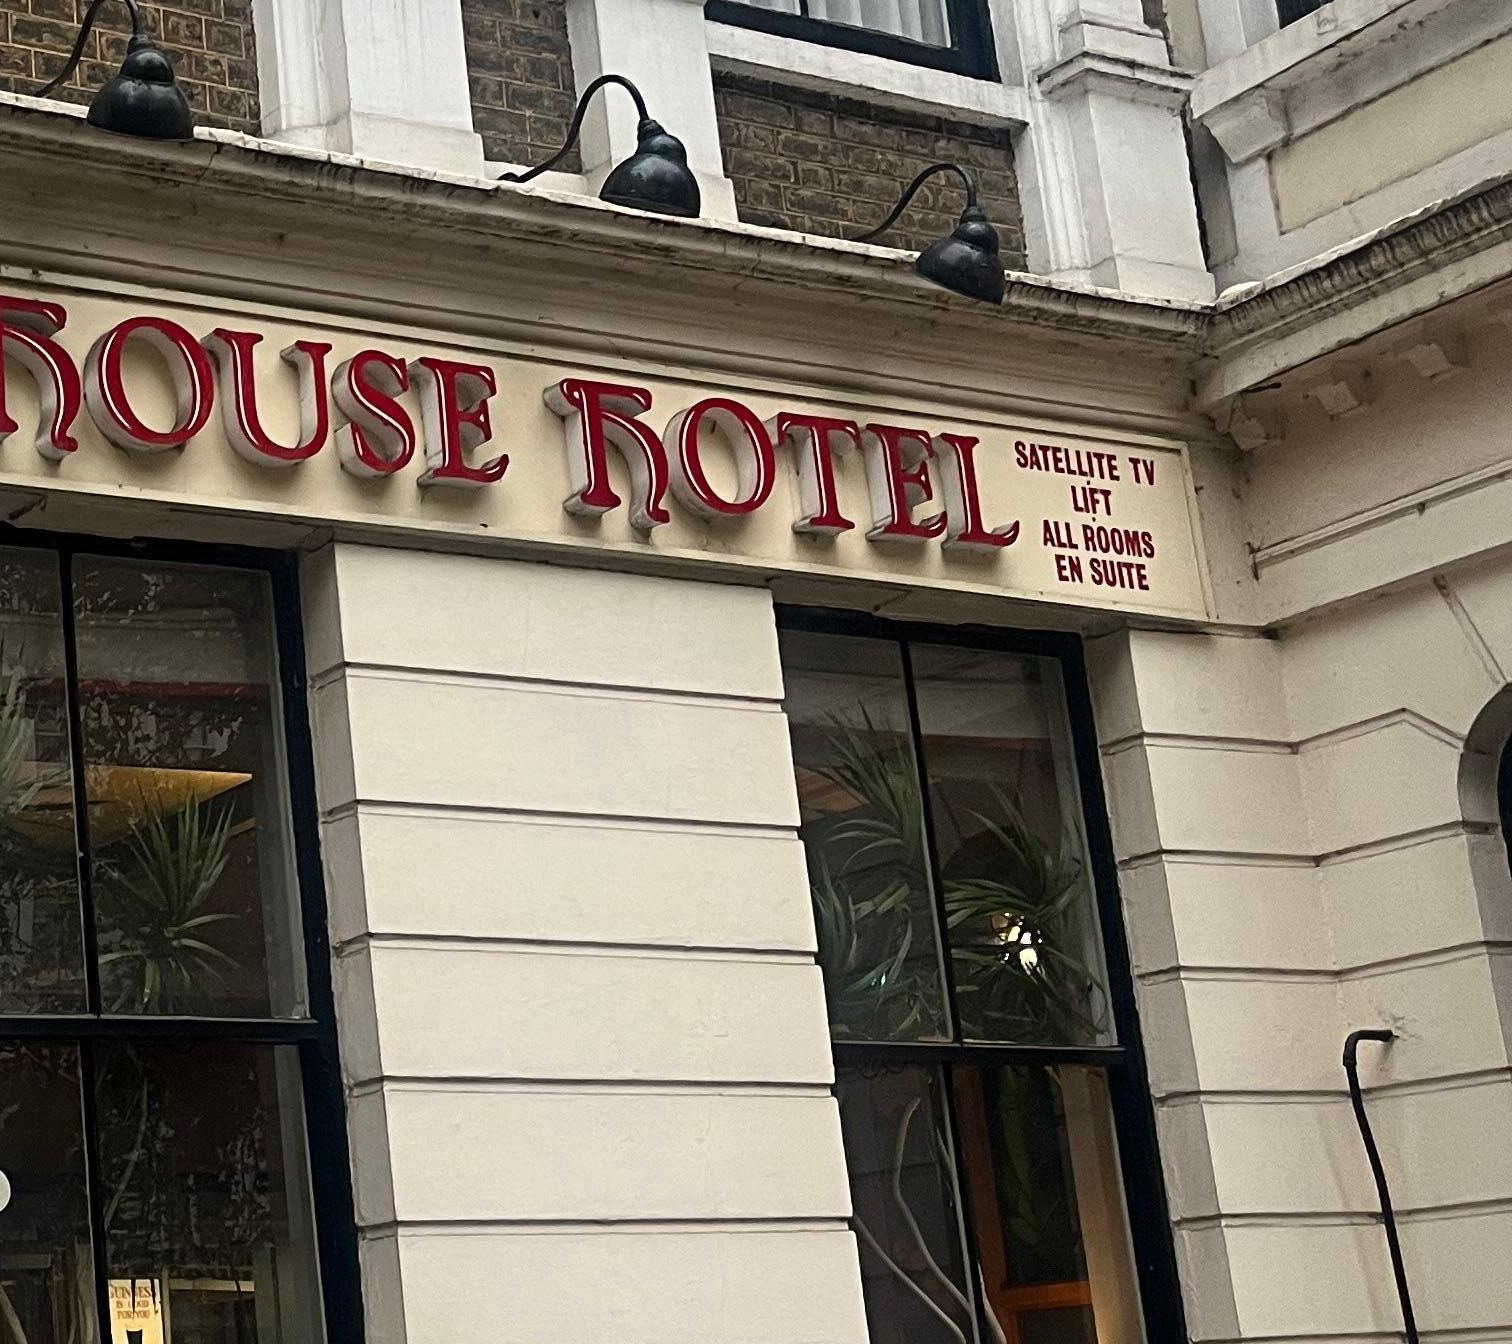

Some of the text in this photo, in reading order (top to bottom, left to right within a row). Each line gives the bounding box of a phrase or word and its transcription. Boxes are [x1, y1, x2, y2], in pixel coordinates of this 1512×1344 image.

[560, 377, 1020, 546] HOTEL
[1014, 441, 1155, 485] SATELLITE TV
[1070, 485, 1112, 516] LIFT
[1043, 520, 1154, 558] ALL ROOMS
[1055, 554, 1149, 590] EN SUITE
